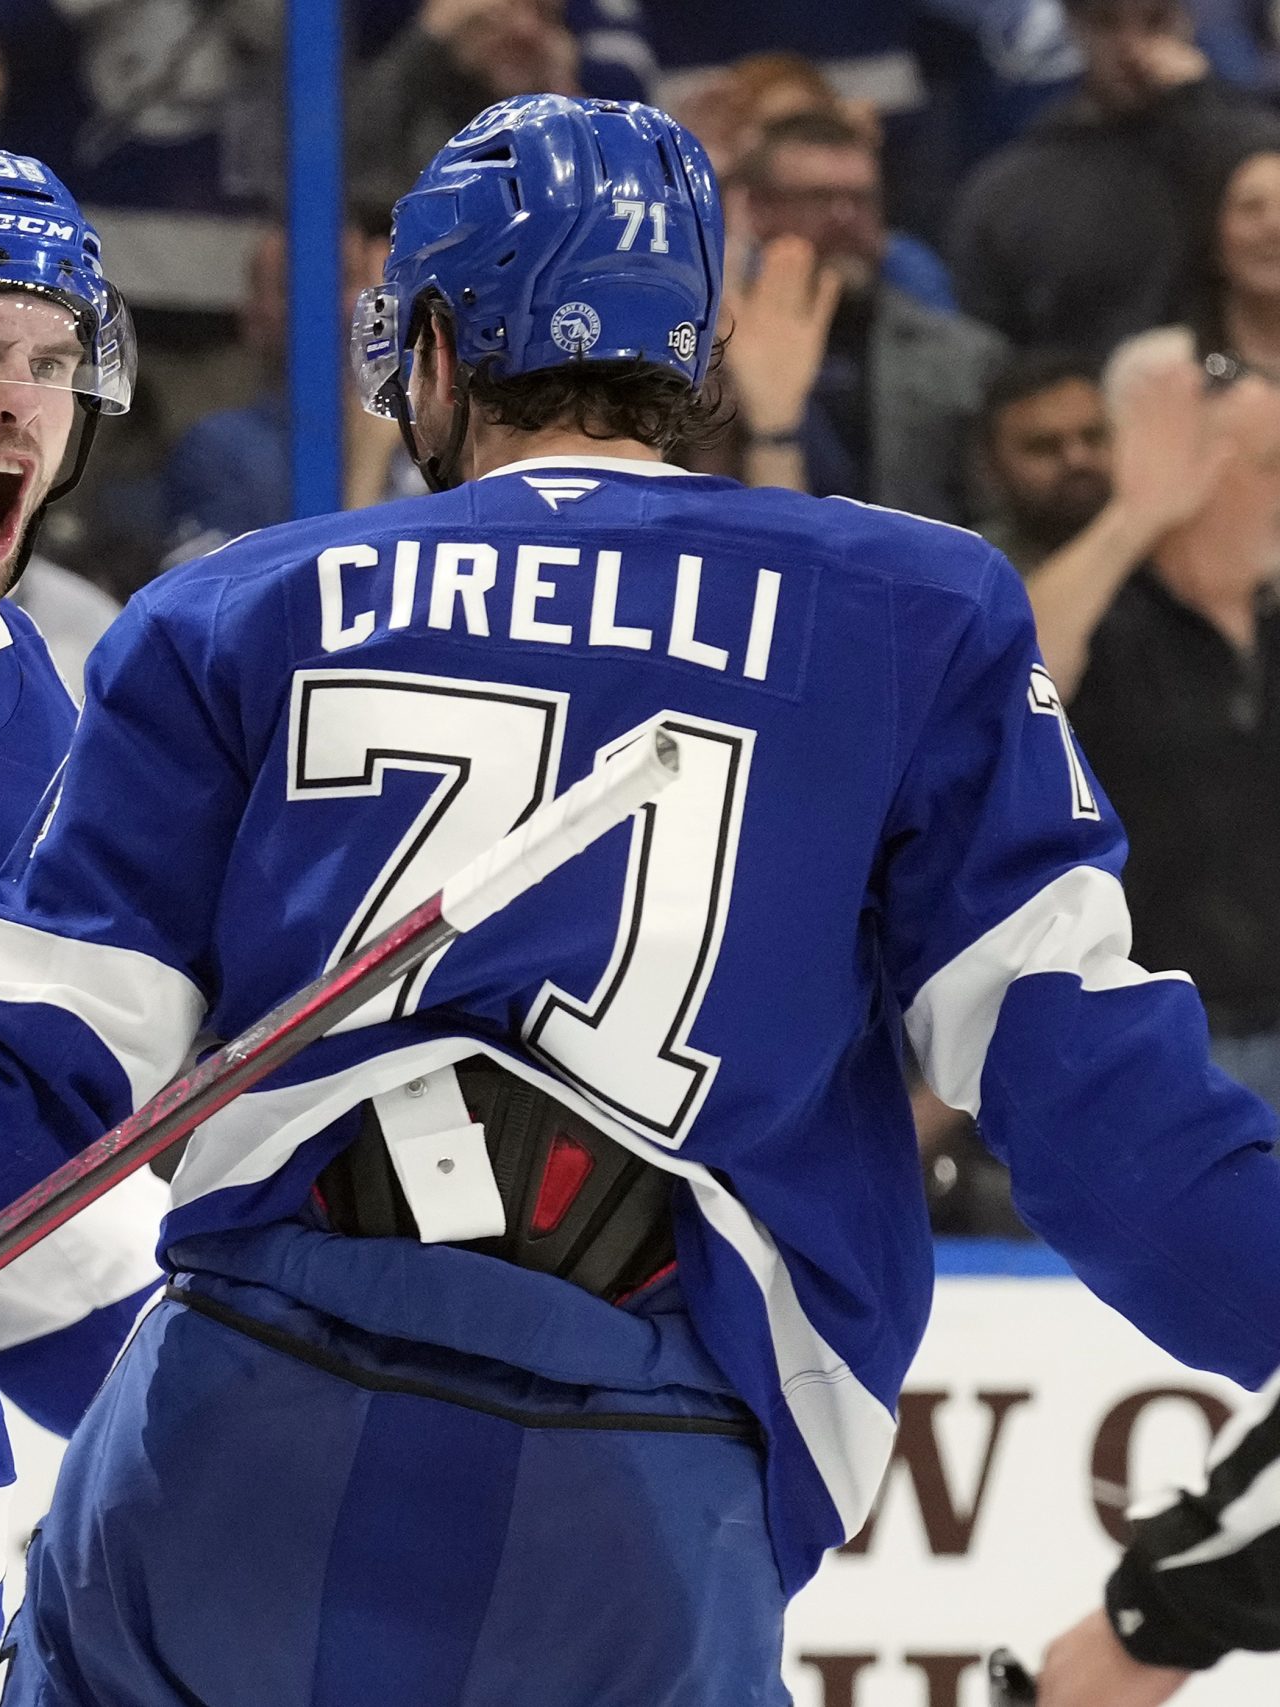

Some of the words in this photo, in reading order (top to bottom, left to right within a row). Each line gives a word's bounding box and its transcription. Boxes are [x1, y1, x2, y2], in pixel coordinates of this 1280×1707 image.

[613, 200, 669, 254] 71
[317, 541, 782, 681] CIRELLI
[287, 668, 757, 1150] 71
